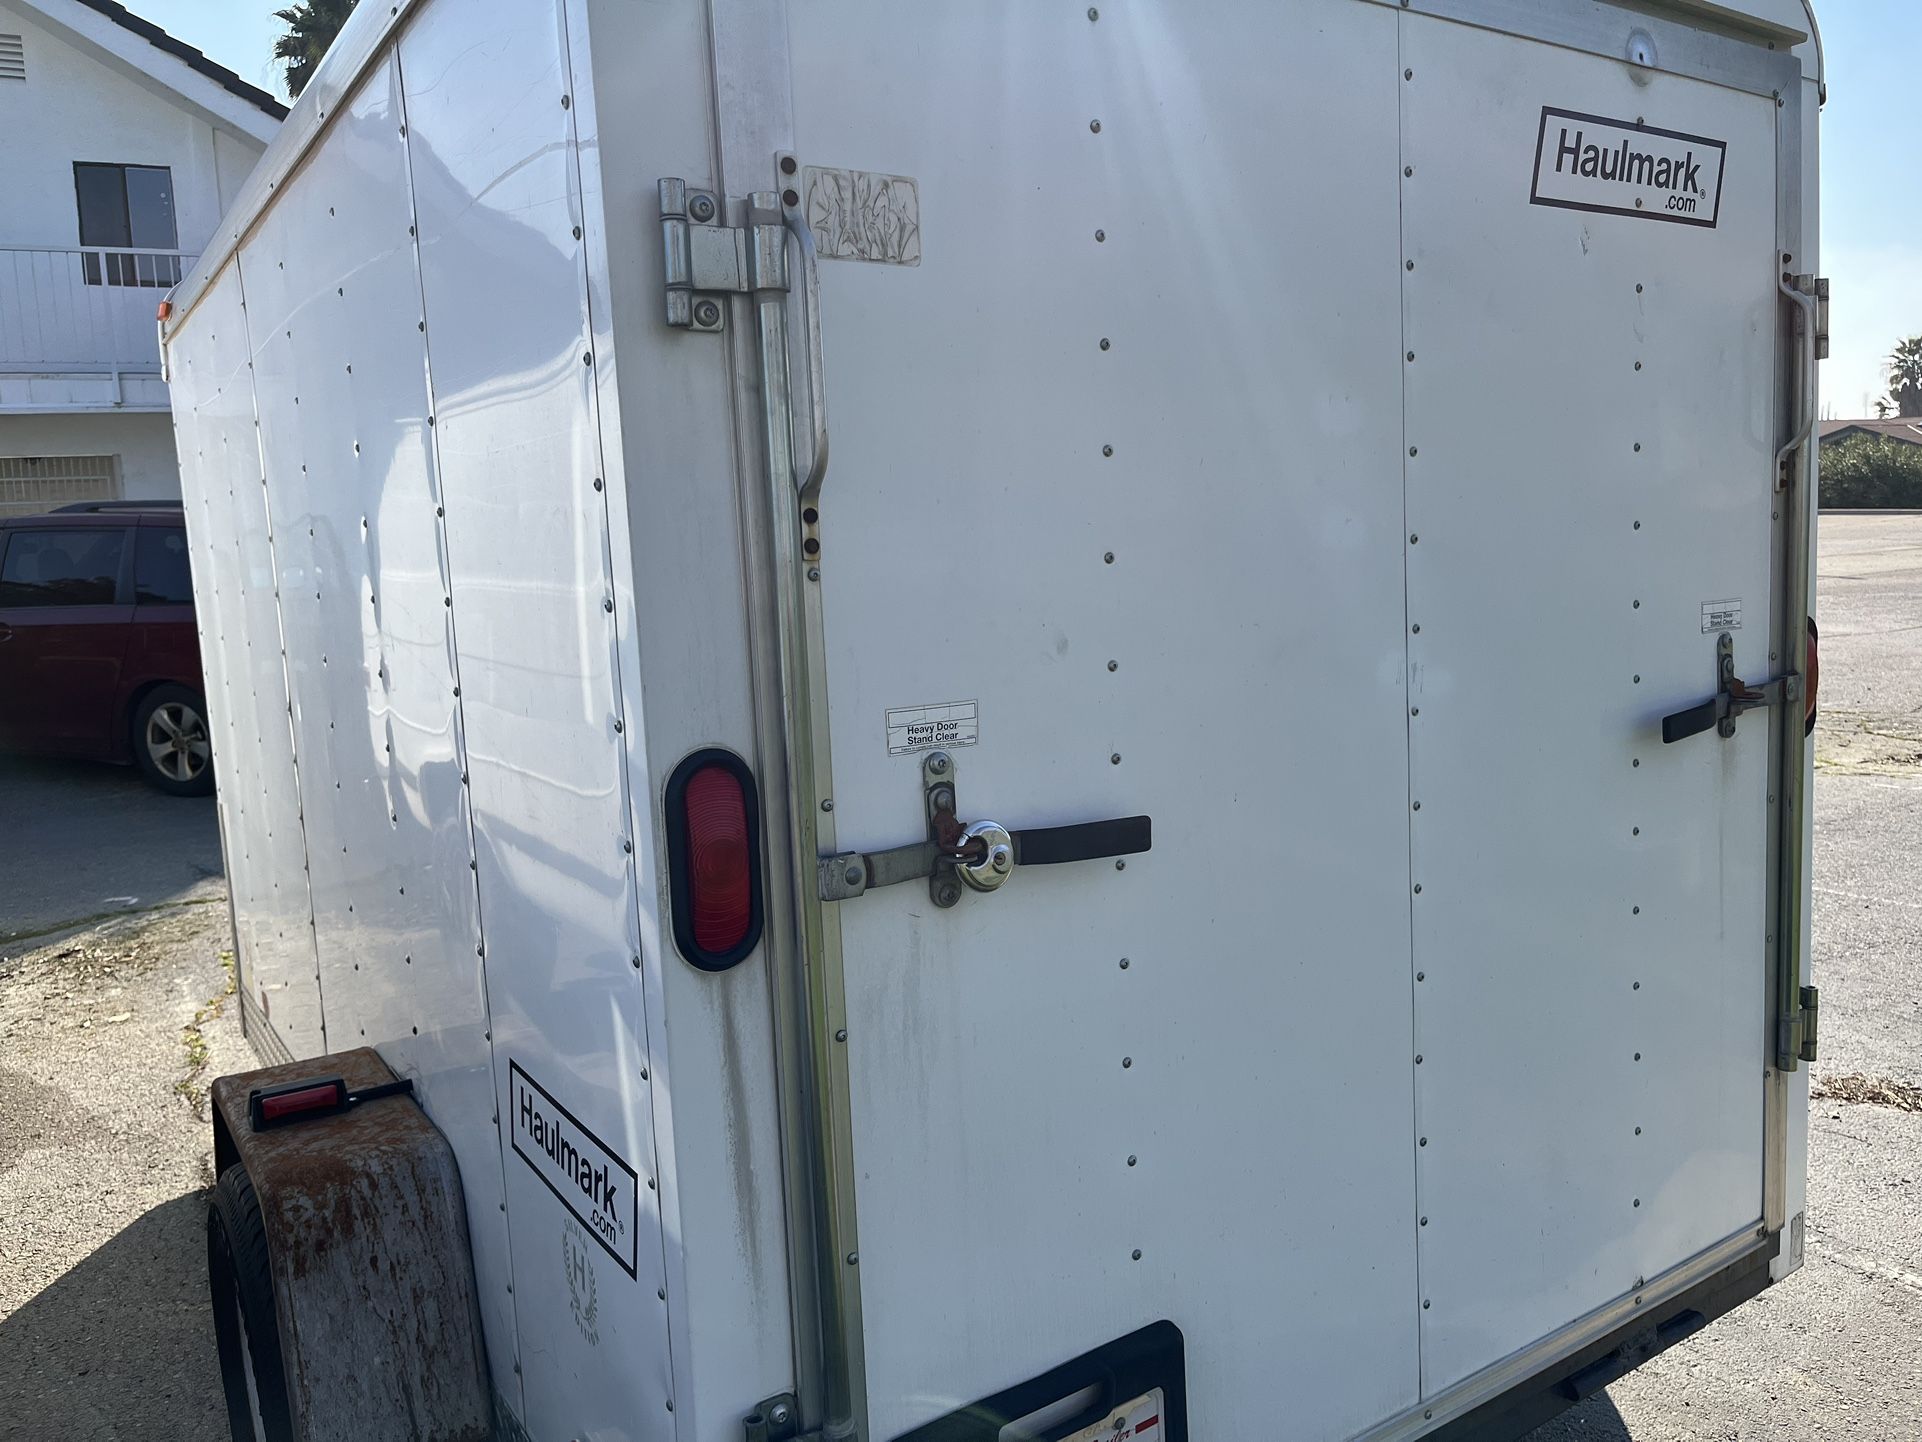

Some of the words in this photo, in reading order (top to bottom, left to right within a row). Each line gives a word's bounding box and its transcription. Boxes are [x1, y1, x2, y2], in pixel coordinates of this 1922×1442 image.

[1555, 128, 1701, 194] Haulmark
[1664, 195, 1697, 213] .com
[907, 724, 935, 735] Heavy
[936, 722, 958, 731] Door
[907, 734, 933, 745] Stand
[935, 732, 959, 741] Clear
[520, 1085, 618, 1223] Haulmark
[590, 1207, 617, 1245] .com
